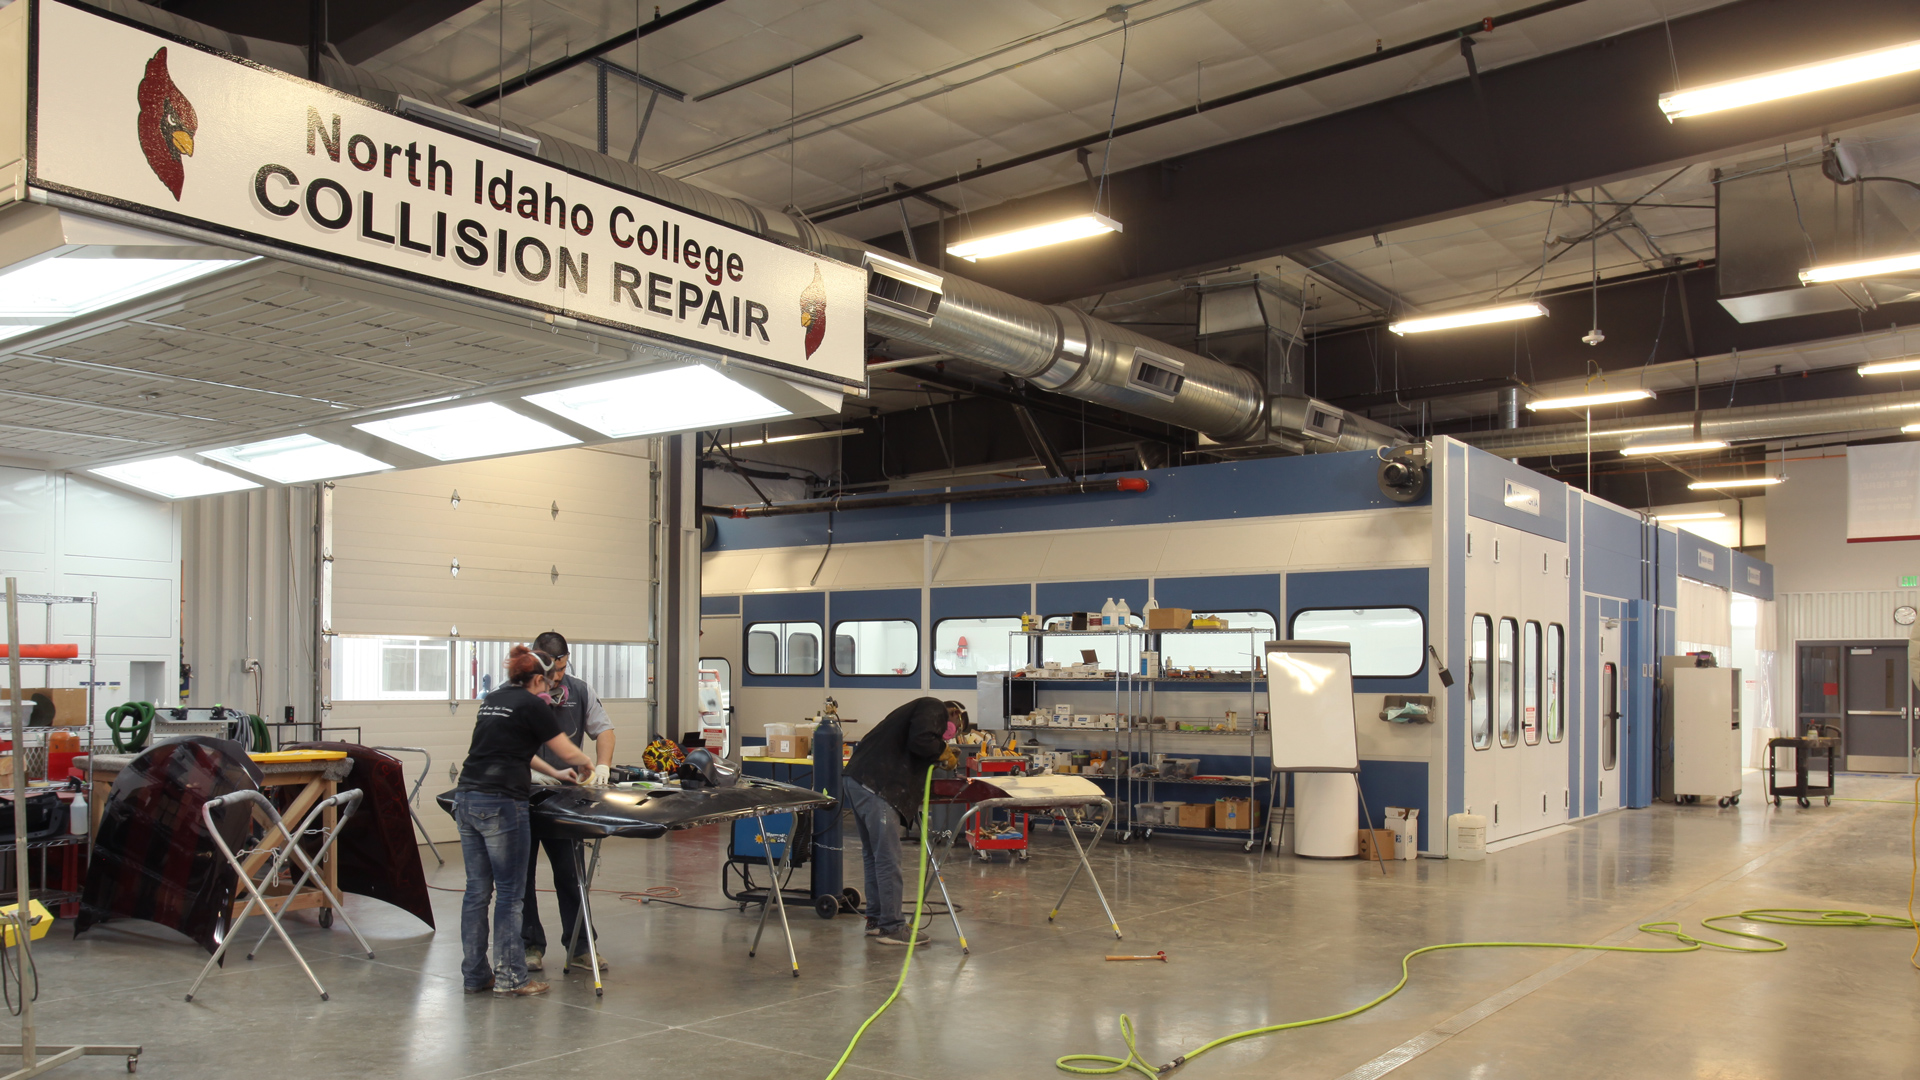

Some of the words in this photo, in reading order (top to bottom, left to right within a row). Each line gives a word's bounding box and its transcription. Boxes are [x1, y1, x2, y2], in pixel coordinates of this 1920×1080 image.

[254, 163, 589, 295] COLLISION
[612, 261, 770, 342] REPAIR
[306, 105, 452, 196] North
[474, 159, 594, 236] Idaho
[609, 206, 744, 286] College
[1901, 576, 1917, 587] EXIT
